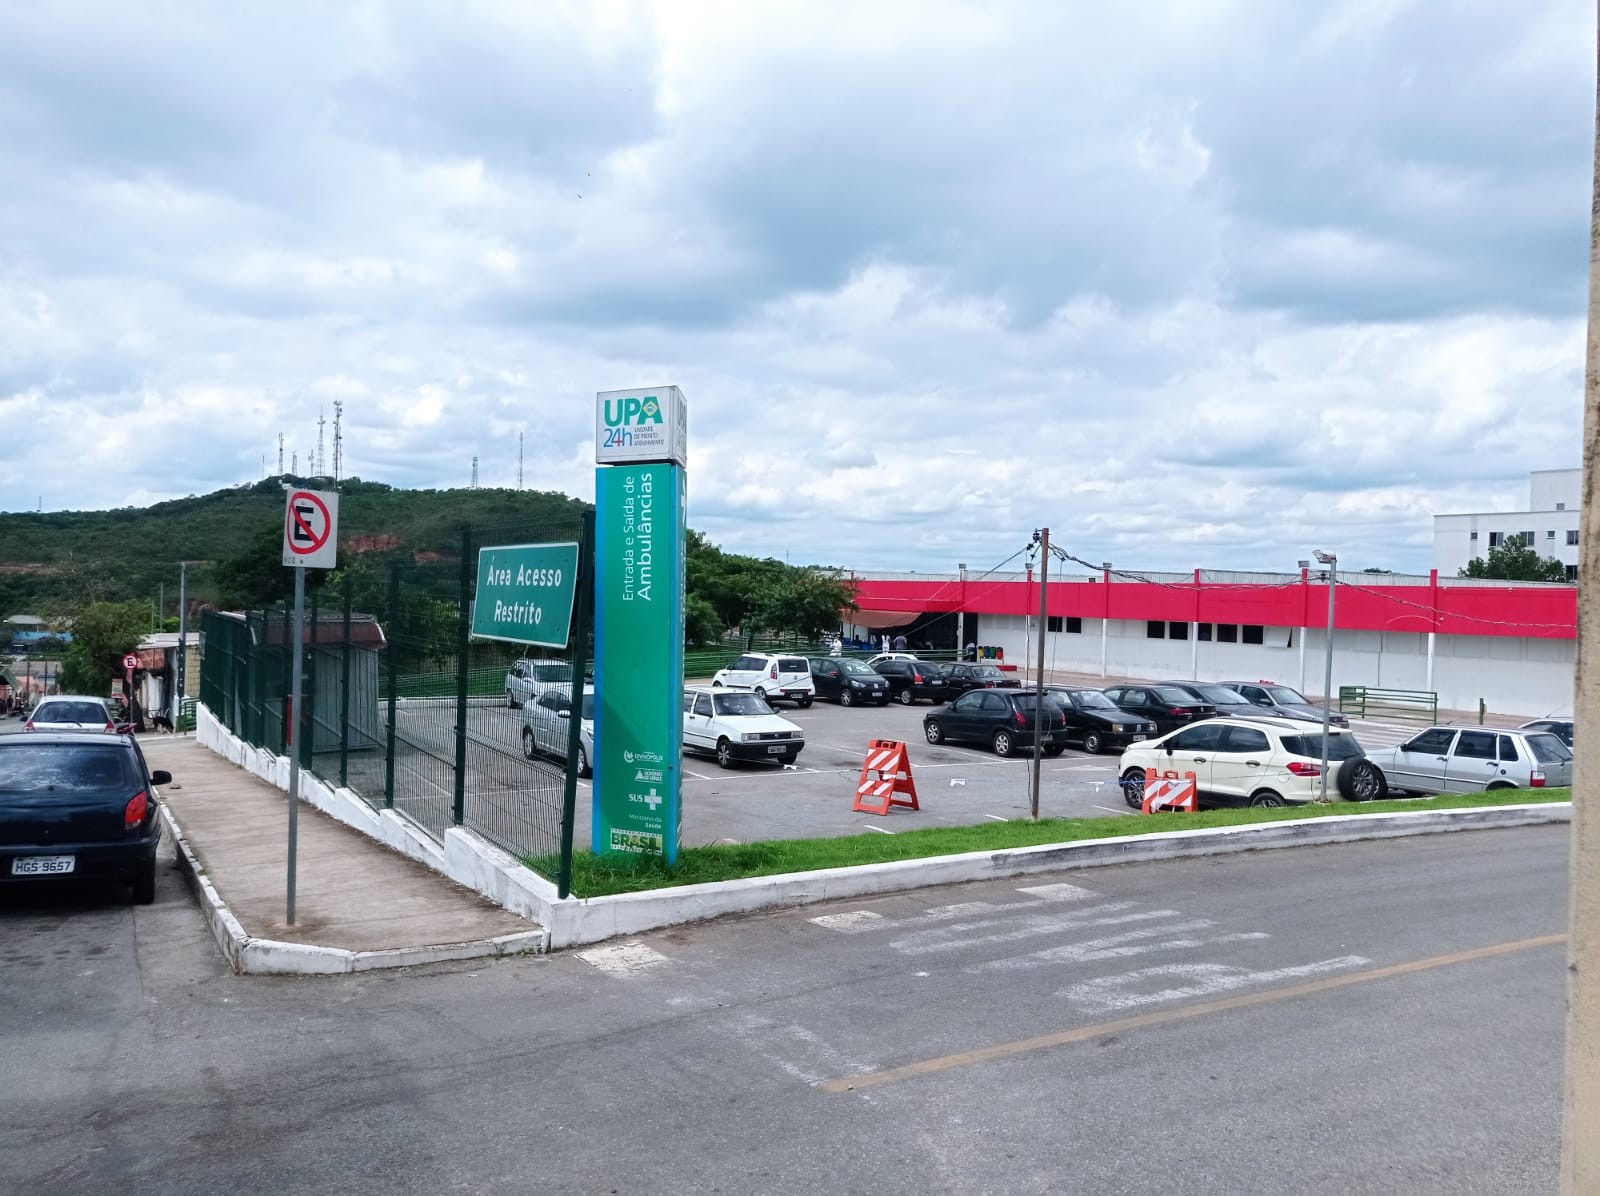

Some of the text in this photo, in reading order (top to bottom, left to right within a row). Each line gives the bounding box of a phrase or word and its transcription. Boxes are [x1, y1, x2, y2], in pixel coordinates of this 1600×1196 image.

[604, 396, 664, 427] UPA
[603, 428, 633, 448] 24h
[622, 476, 635, 601] Entrada e Saída de
[637, 473, 653, 601] Ambulâncias
[486, 555, 563, 588] Área Acesso
[494, 600, 543, 626] Restrito
[628, 793, 644, 803] SUS
